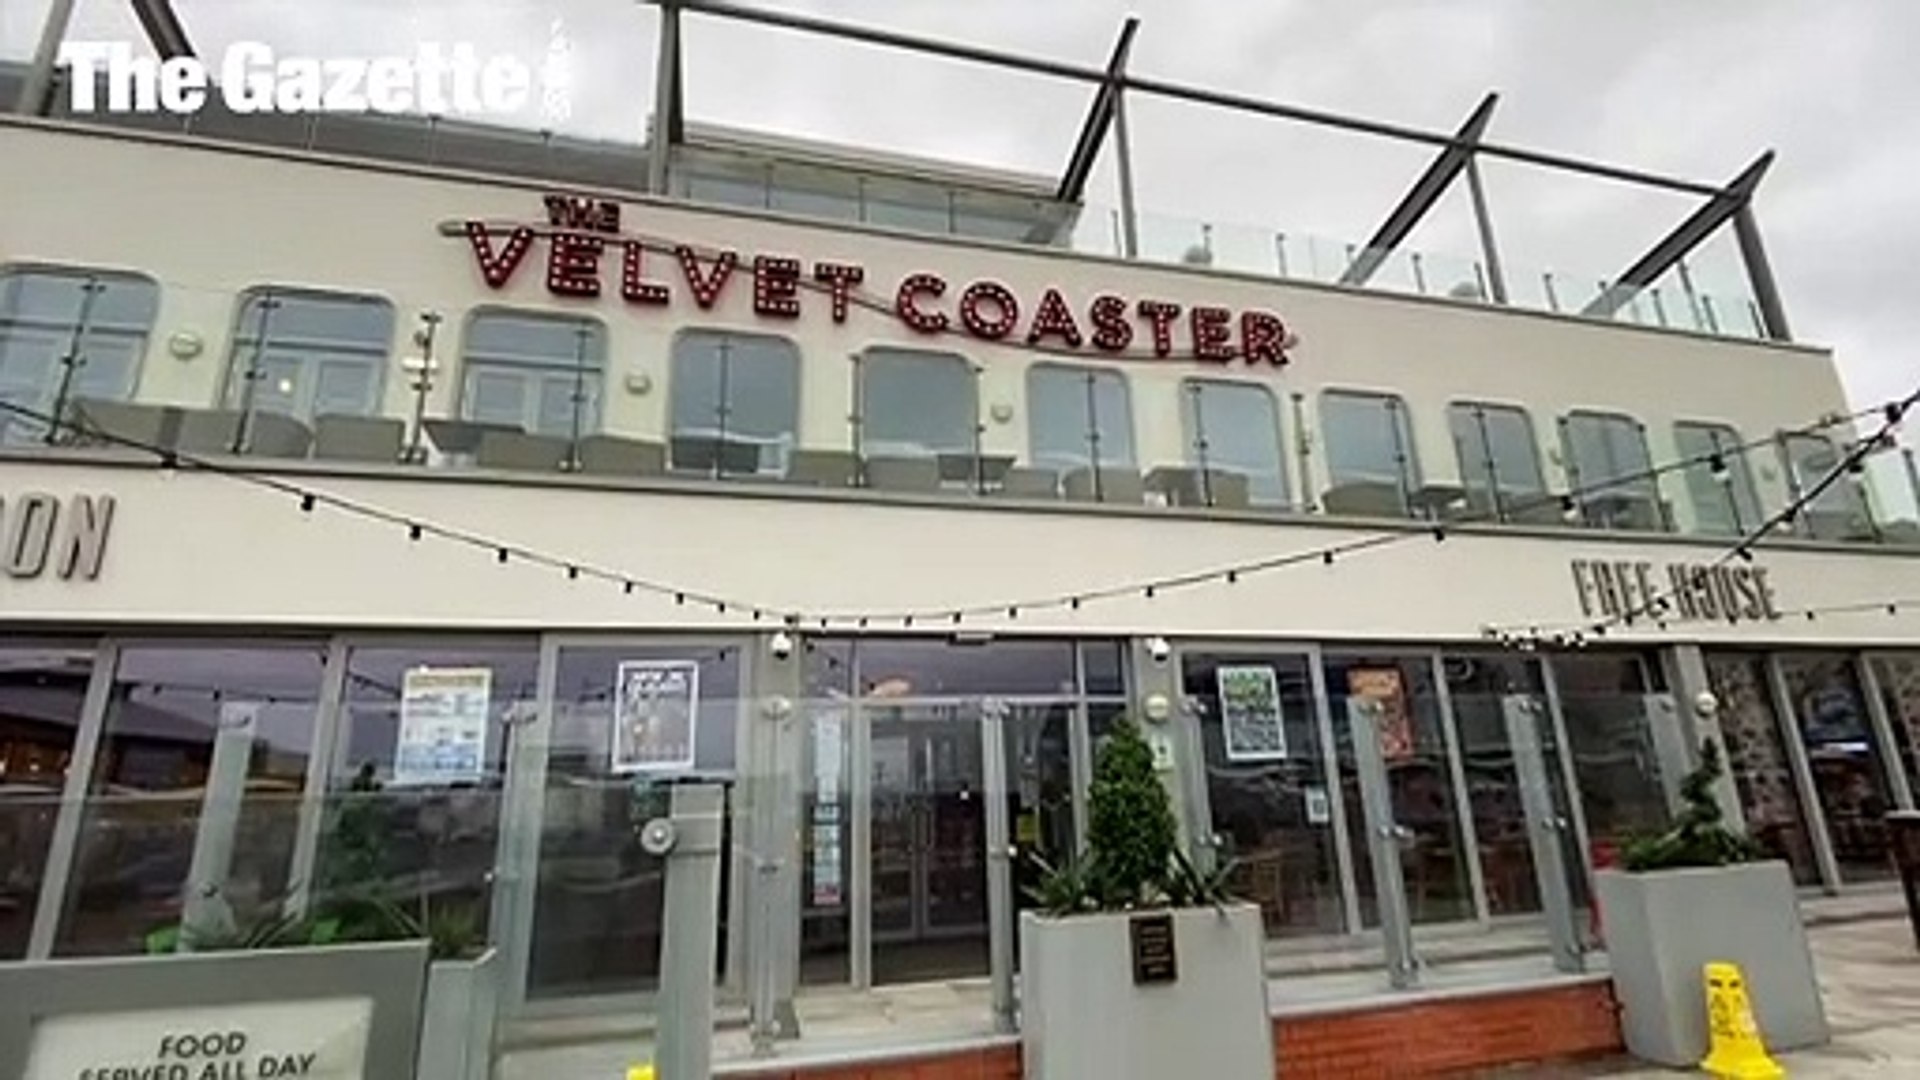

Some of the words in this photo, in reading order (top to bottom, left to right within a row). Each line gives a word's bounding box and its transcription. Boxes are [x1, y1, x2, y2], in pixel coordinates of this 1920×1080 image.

[544, 195, 620, 233] THE
[465, 220, 864, 323] VELVET
[896, 273, 1290, 366] COASTER
[0, 494, 116, 581] ON
[1571, 556, 1663, 620] FREE
[1667, 563, 1783, 621] HOUSE
[78, 1063, 190, 1080] SERVED
[199, 1060, 246, 1080] ALL
[258, 1052, 316, 1079] DAY
[157, 1031, 247, 1059] FOOD
